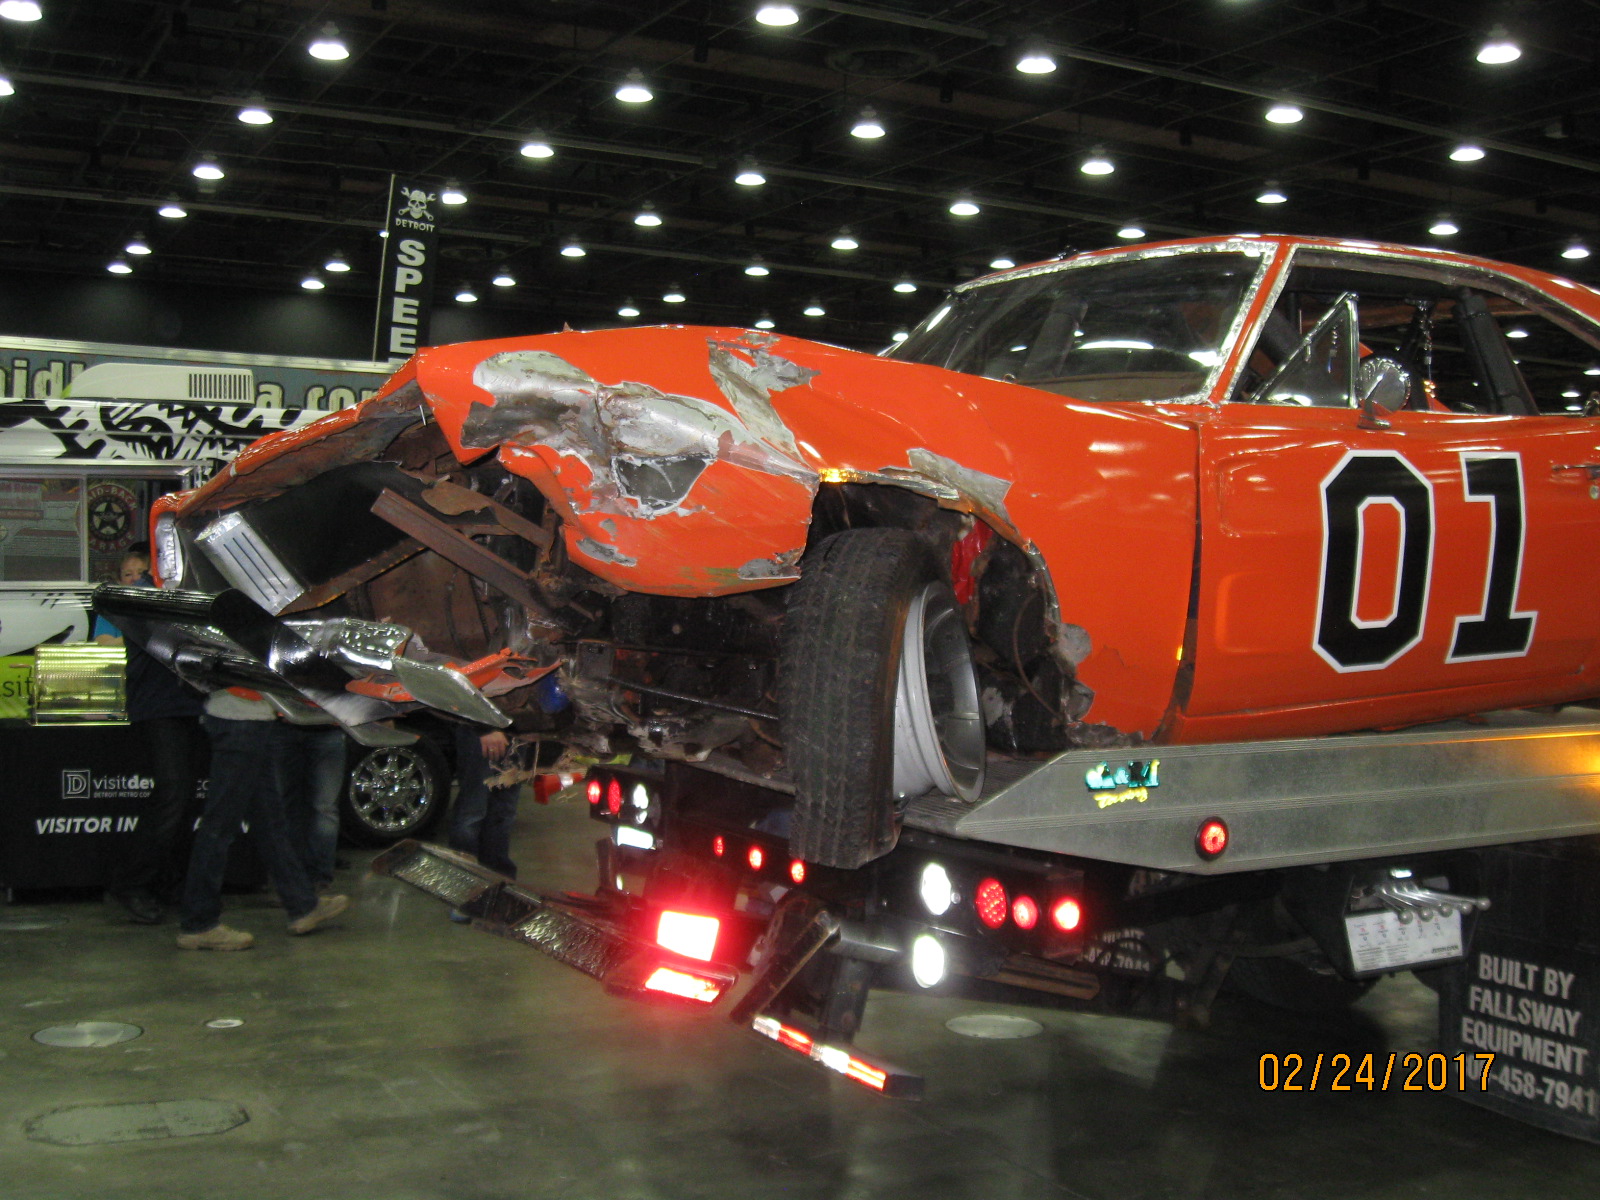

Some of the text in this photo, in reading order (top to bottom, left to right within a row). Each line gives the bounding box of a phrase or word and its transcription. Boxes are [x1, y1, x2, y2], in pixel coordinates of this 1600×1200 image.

[395, 217, 435, 233] DETROIT
[388, 239, 426, 366] SPEE
[1312, 449, 1538, 674] 01
[36, 817, 111, 835] VISITOR
[1478, 953, 1576, 1000] BUILT BY
[1469, 985, 1583, 1038] FALLSWAY
[1461, 1017, 1589, 1077] EQUIPMENT
